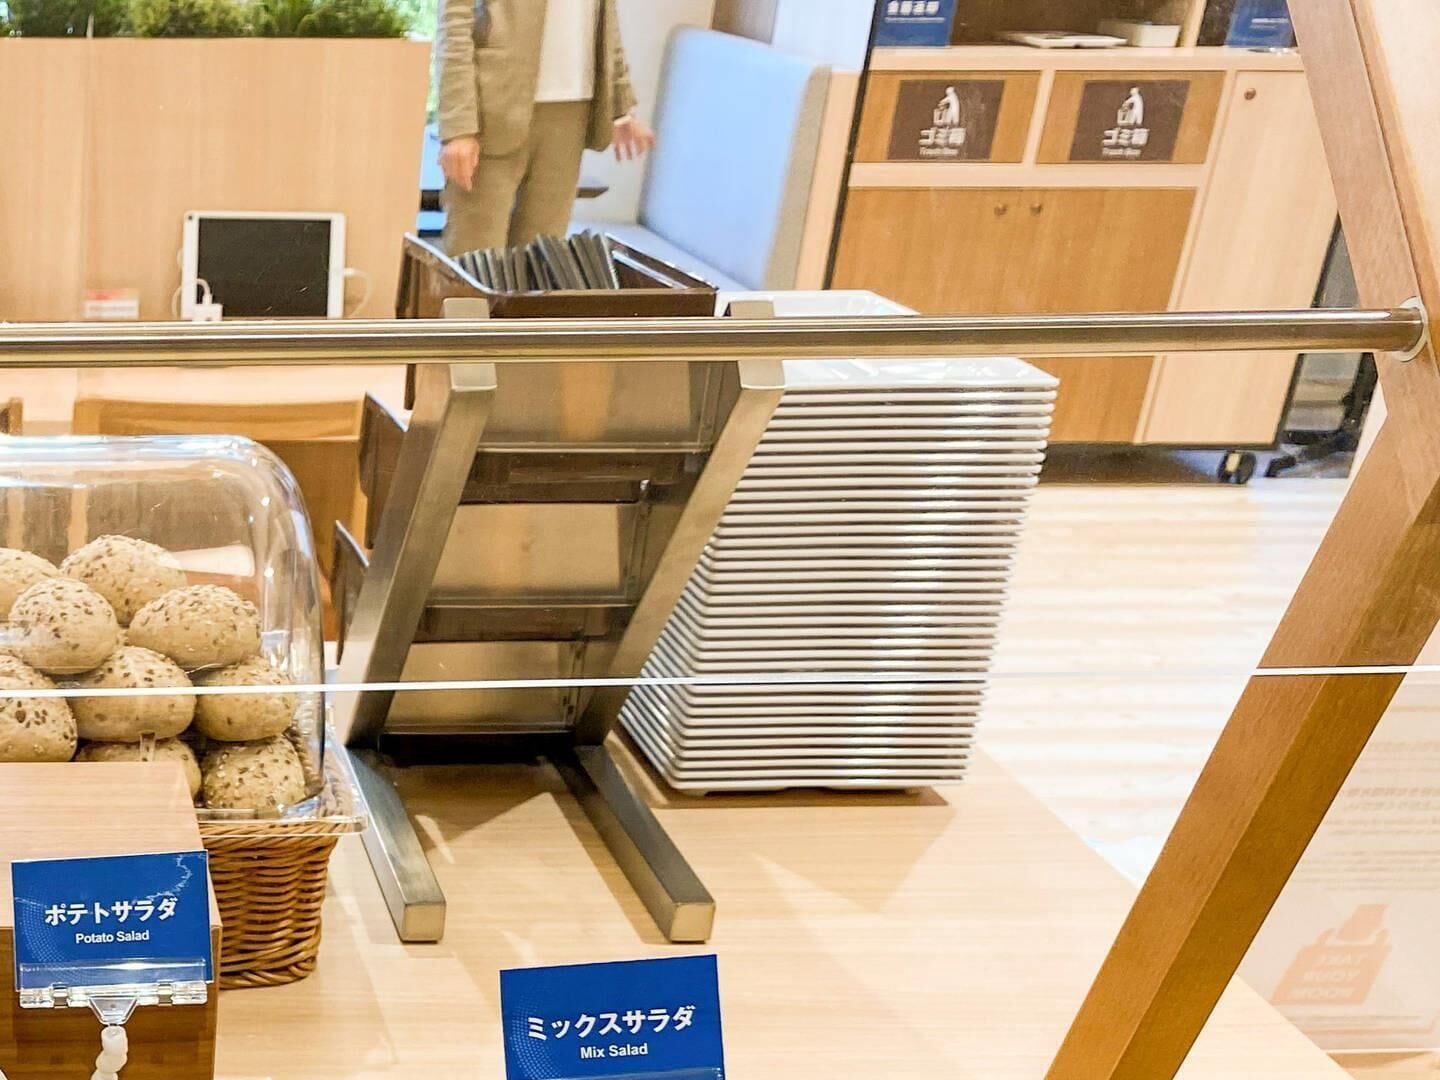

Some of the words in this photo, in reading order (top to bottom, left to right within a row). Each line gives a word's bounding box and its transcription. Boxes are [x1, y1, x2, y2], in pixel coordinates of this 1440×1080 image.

[45, 896, 178, 926] ポテトサラダ
[75, 932, 114, 944] Potato
[116, 929, 150, 942] Salad
[527, 1005, 696, 1040] ミックスサラダ
[580, 1046, 605, 1059] Mix
[608, 1042, 649, 1056] Salad
